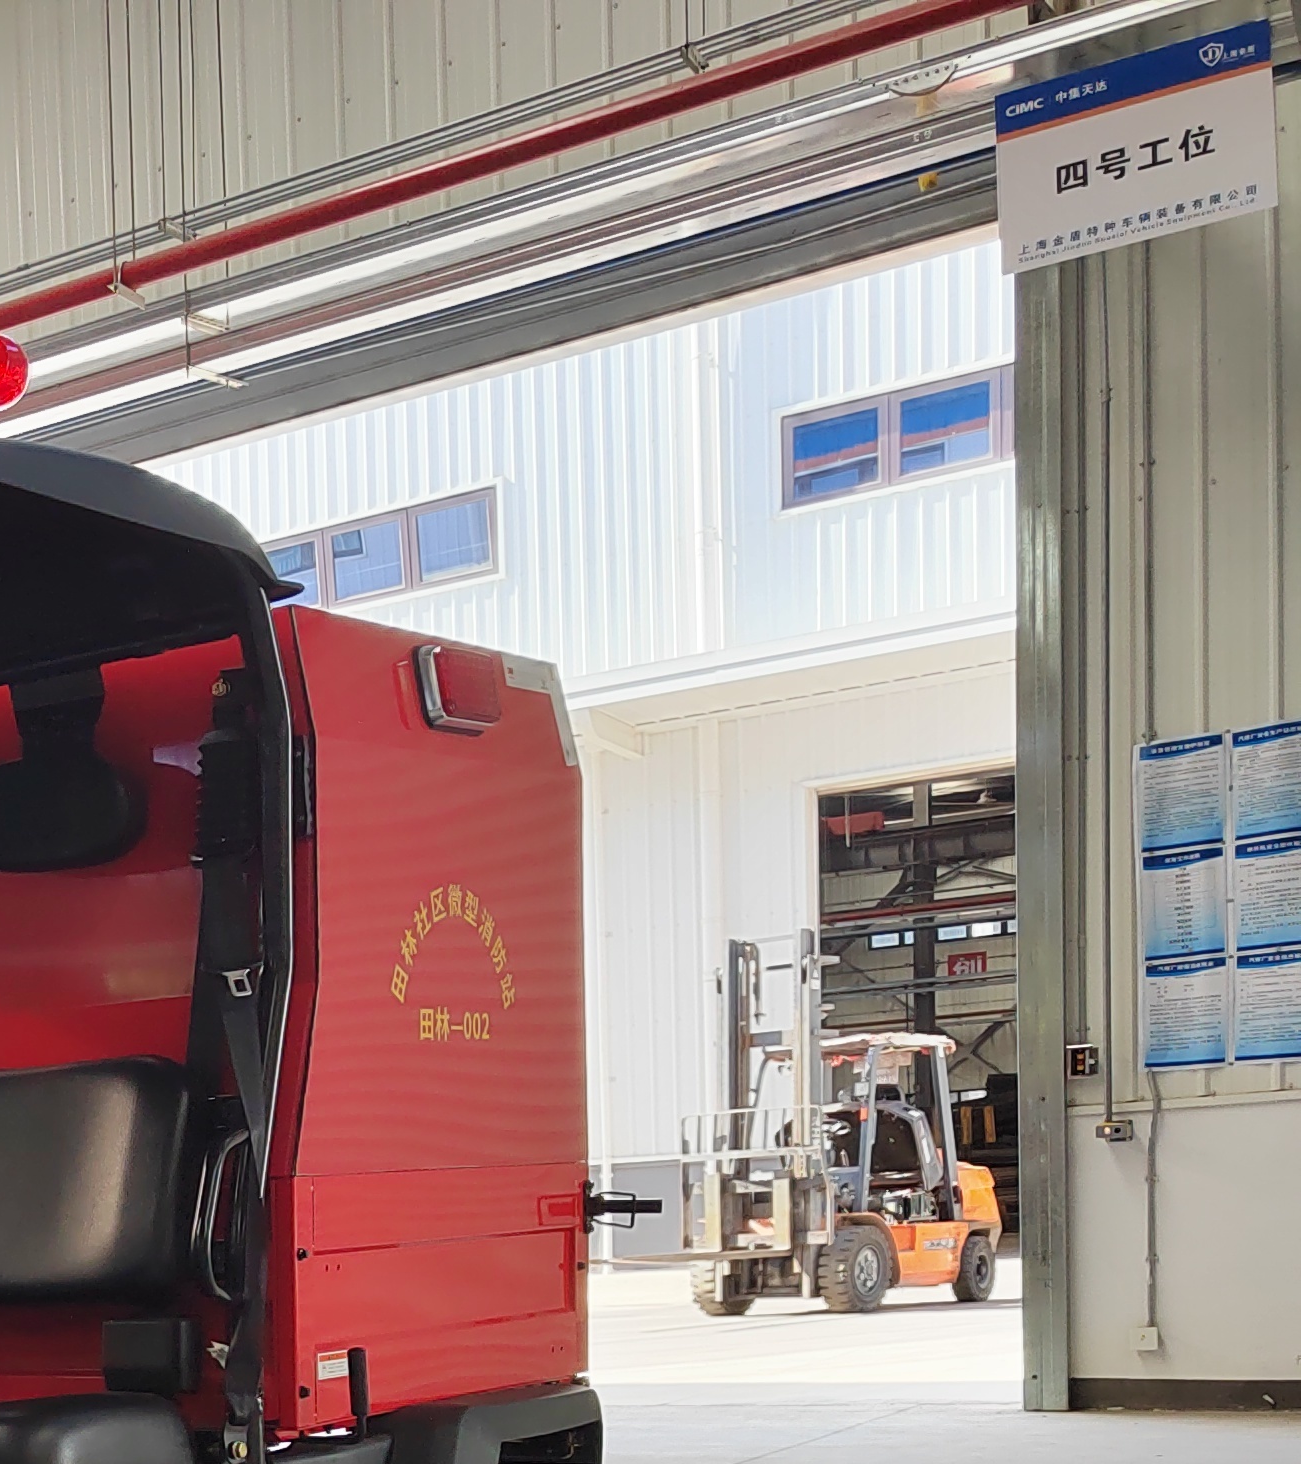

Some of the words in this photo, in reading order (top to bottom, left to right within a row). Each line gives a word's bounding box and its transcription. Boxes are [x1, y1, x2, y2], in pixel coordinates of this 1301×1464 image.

[1005, 98, 1044, 117] CIMC
[1055, 79, 1108, 104] 中集天达
[1055, 124, 1216, 195] 四号工位
[1018, 184, 1257, 256] 上海金盾特种车辆装备有限公司
[390, 883, 517, 1010] 田林社区微型消防站
